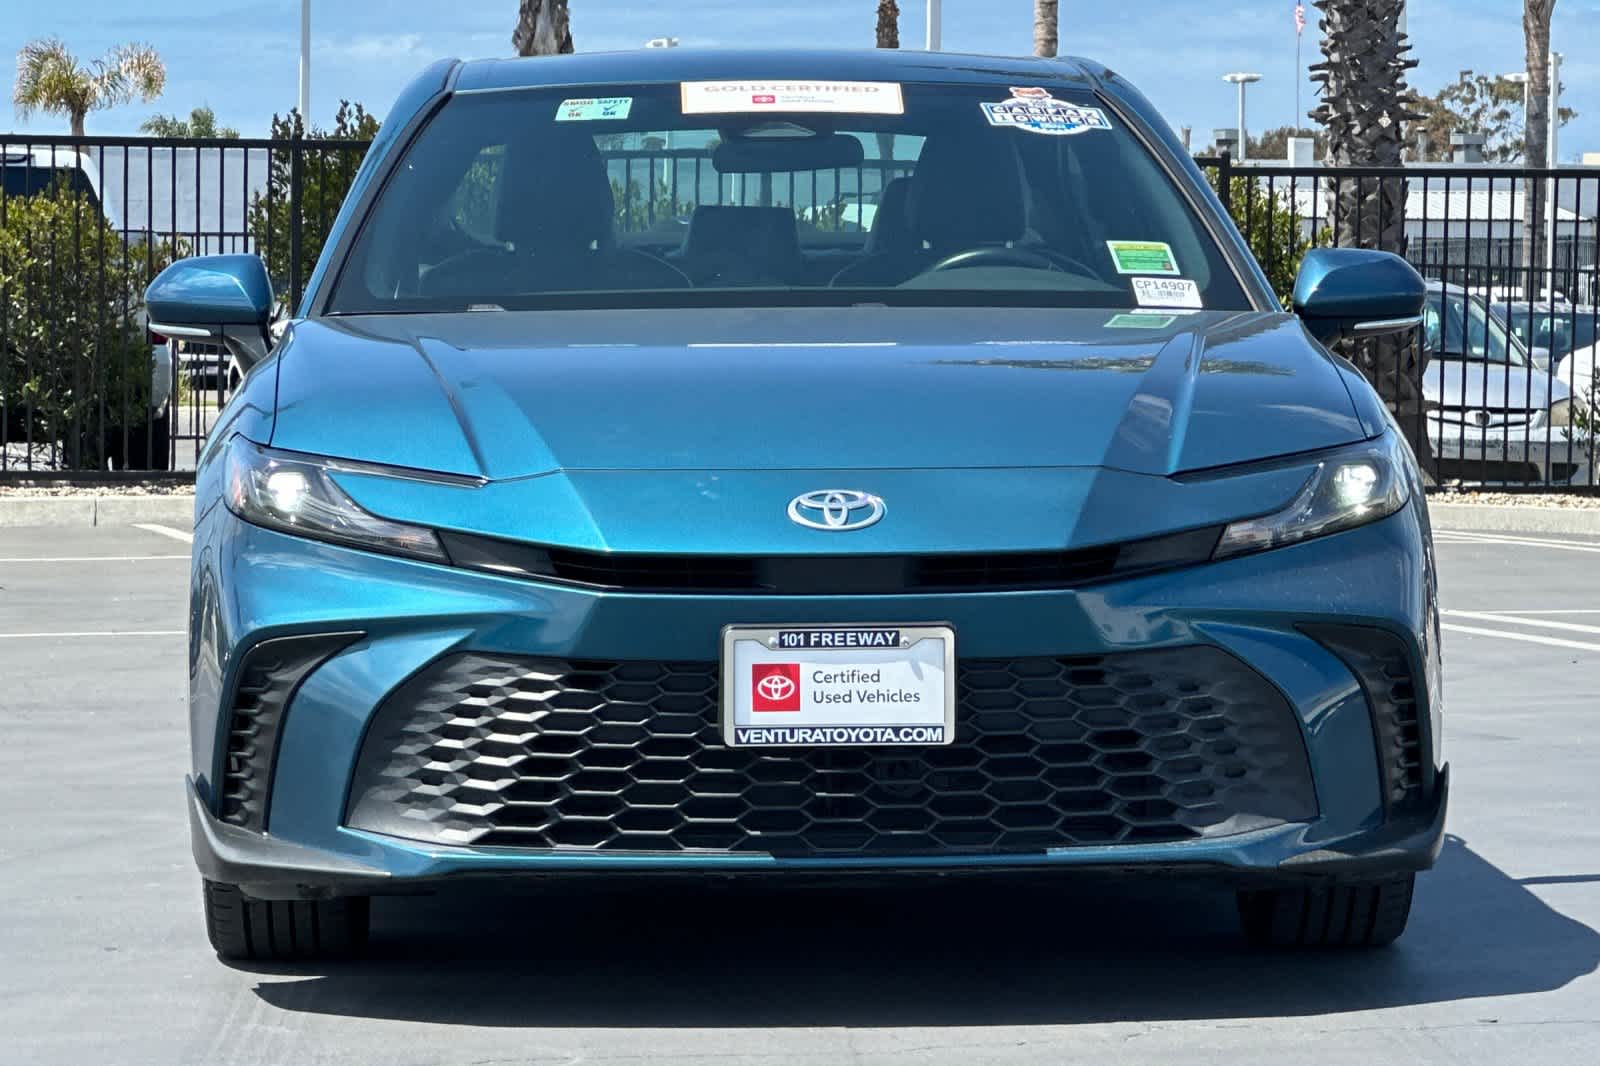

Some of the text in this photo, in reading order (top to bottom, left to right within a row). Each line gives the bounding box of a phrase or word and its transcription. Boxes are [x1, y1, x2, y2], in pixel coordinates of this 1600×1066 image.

[704, 84, 881, 93] GOLD CERTIFIED
[990, 104, 1099, 118] CARFAX
[1135, 280, 1193, 292] CP14907
[781, 632, 897, 647] 101 FREEWAY
[812, 669, 881, 684] Certified
[813, 689, 920, 704] Used Vehicles
[737, 727, 944, 744] VENTURATOYOTA.COM
